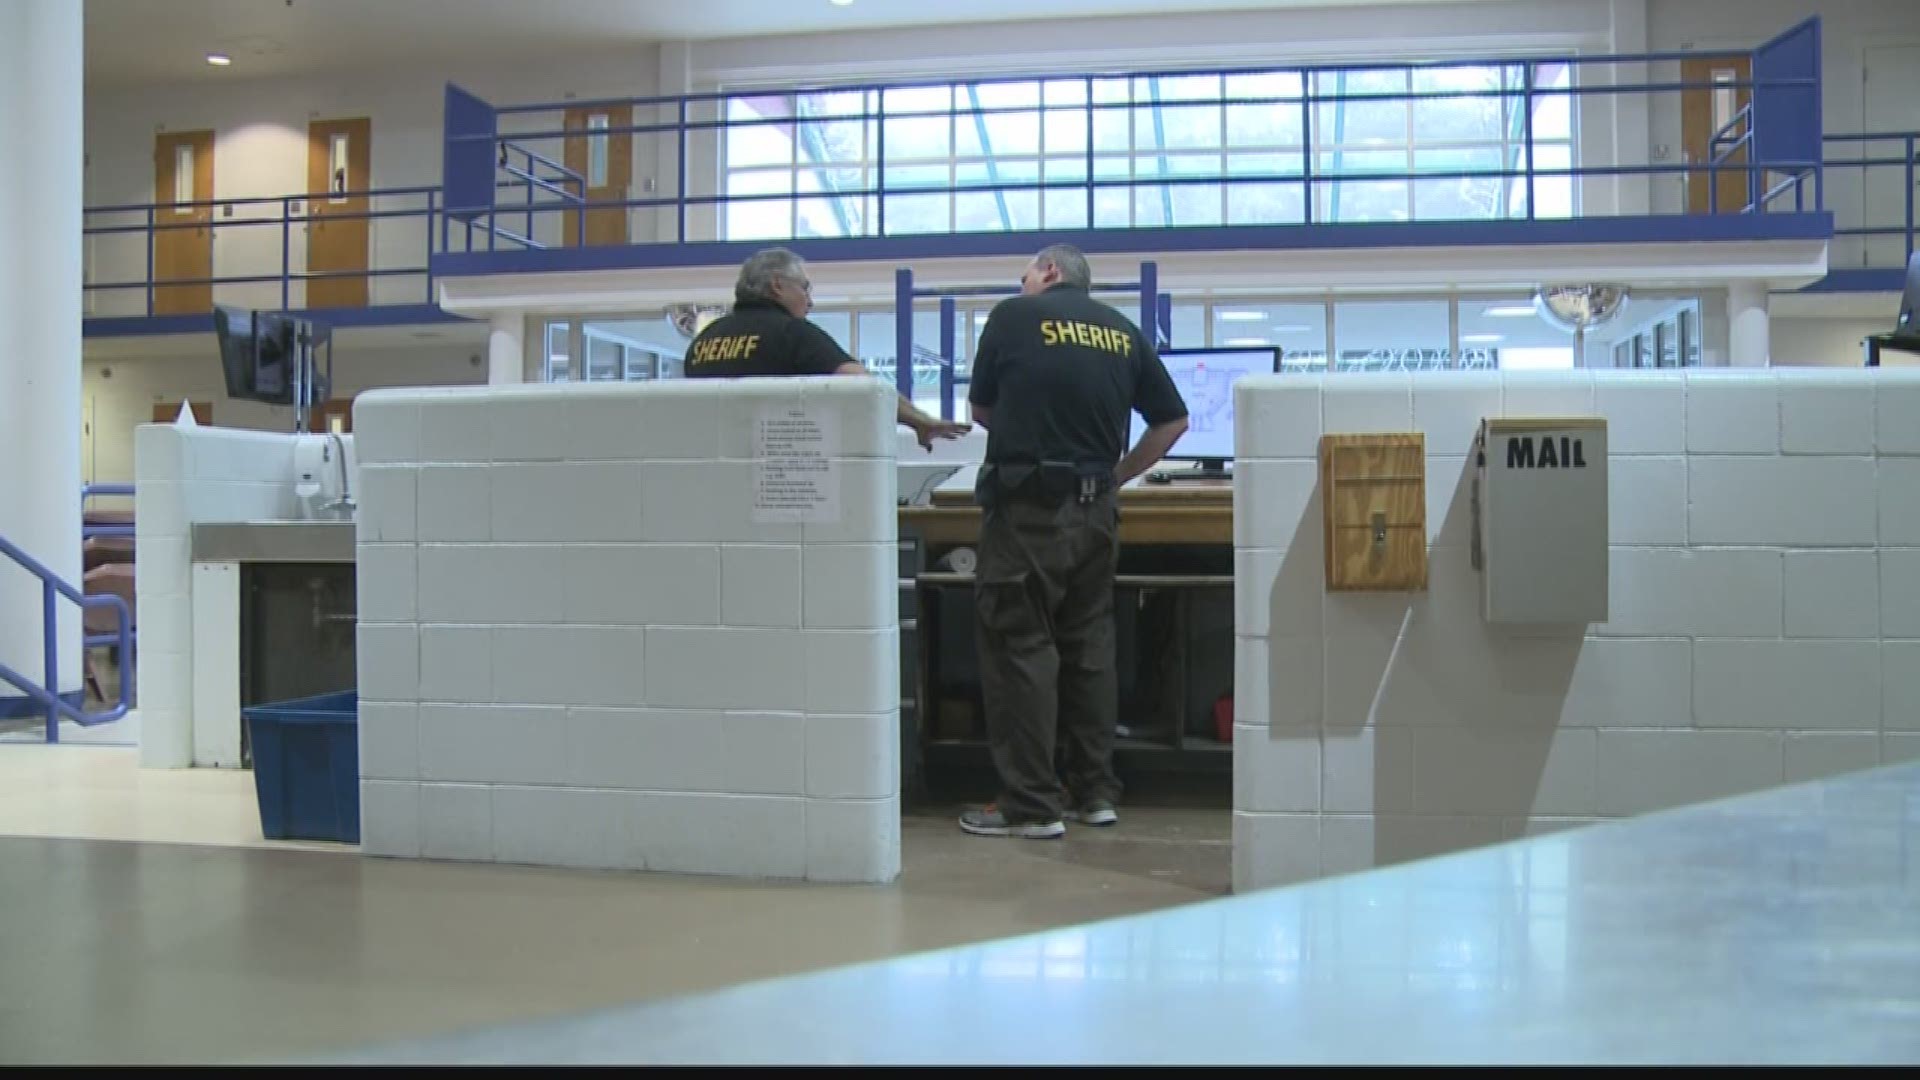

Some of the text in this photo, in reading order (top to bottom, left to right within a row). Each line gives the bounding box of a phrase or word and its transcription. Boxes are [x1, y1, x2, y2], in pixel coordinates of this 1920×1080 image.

[692, 335, 760, 365] SHERIFF
[1040, 320, 1131, 358] SHERIFF
[1507, 436, 1587, 468] MAIL
